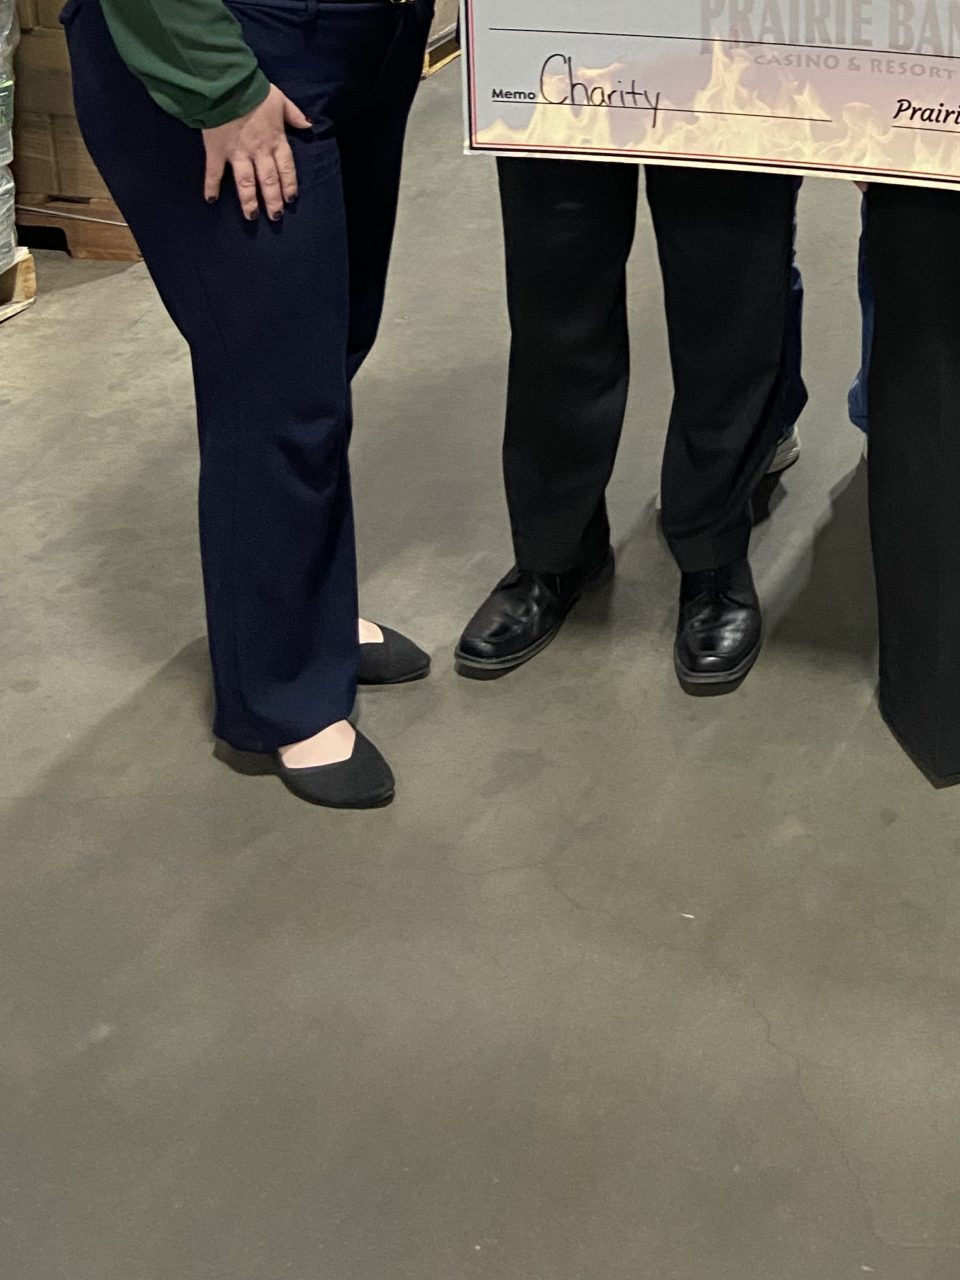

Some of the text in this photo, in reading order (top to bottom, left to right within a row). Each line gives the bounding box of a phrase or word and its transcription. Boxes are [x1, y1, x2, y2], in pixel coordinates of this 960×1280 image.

[753, 53, 957, 80] CASINO & RESORT
[491, 88, 537, 100] Memo
[539, 53, 660, 128] Charity
